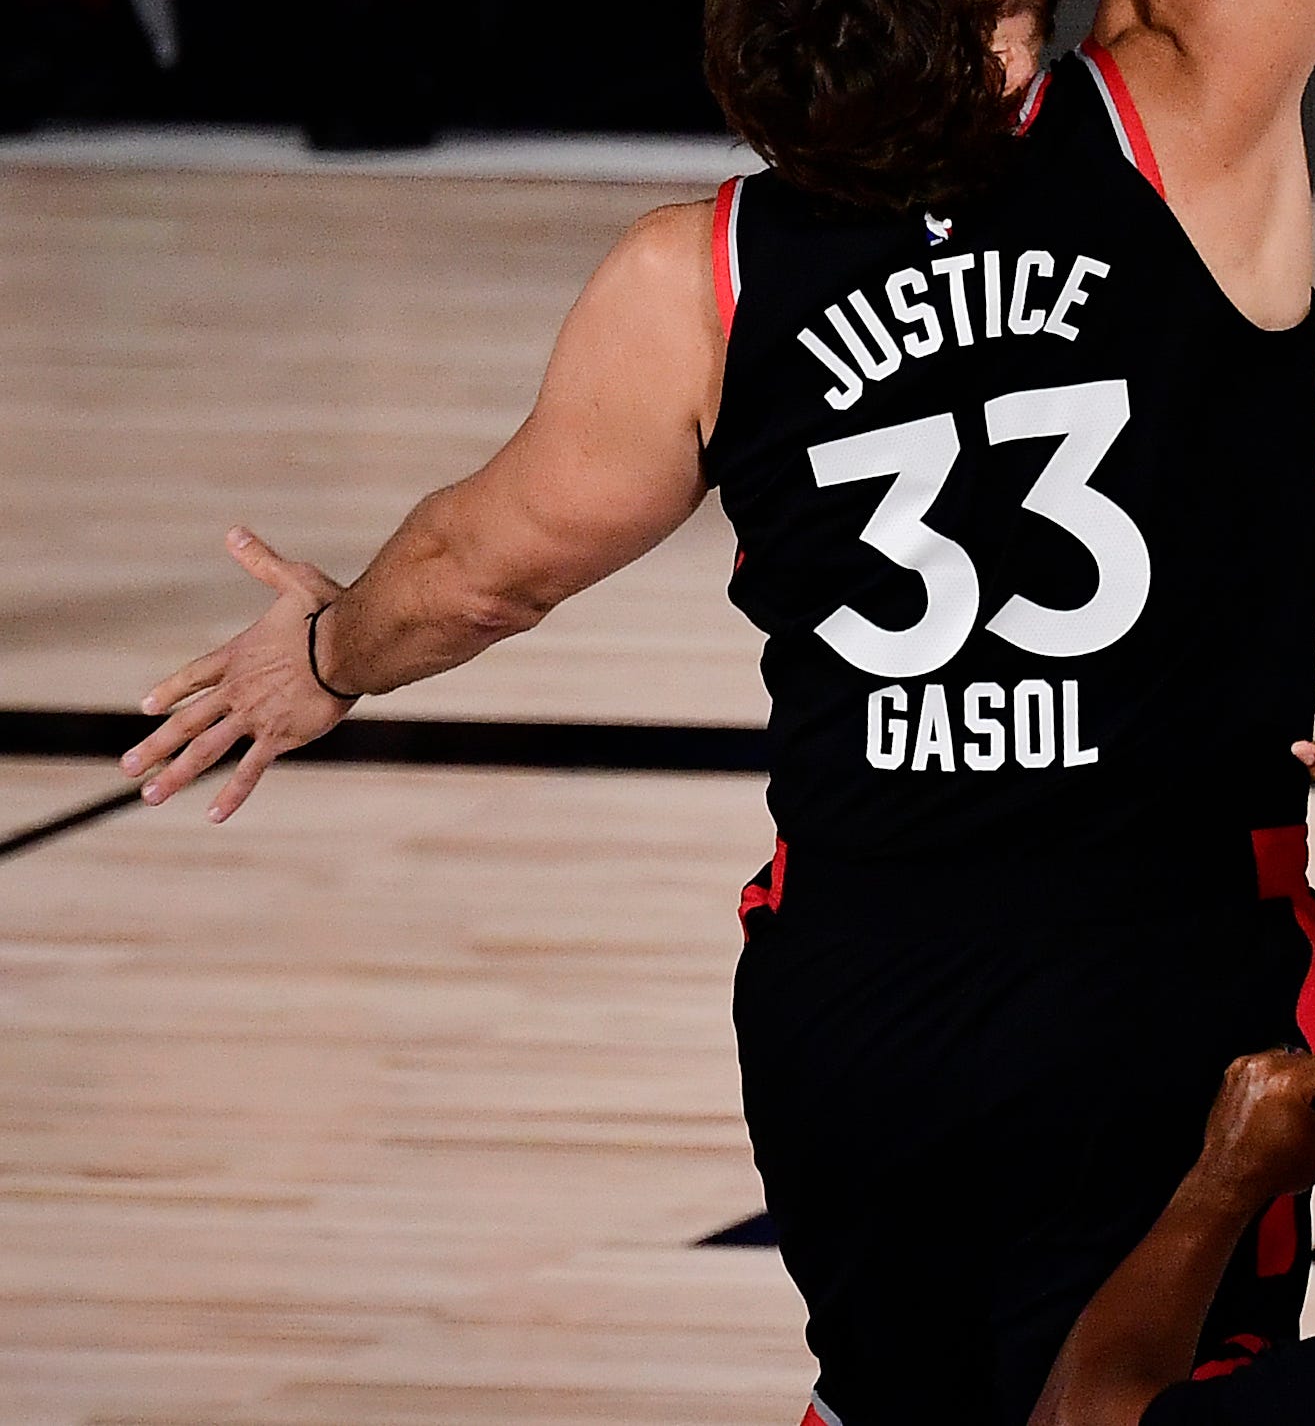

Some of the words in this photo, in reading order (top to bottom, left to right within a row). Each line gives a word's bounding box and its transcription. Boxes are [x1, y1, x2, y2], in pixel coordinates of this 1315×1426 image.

[797, 250, 1110, 410] JUSTICE
[807, 379, 1151, 677] 33
[866, 679, 1099, 772] GASOL
